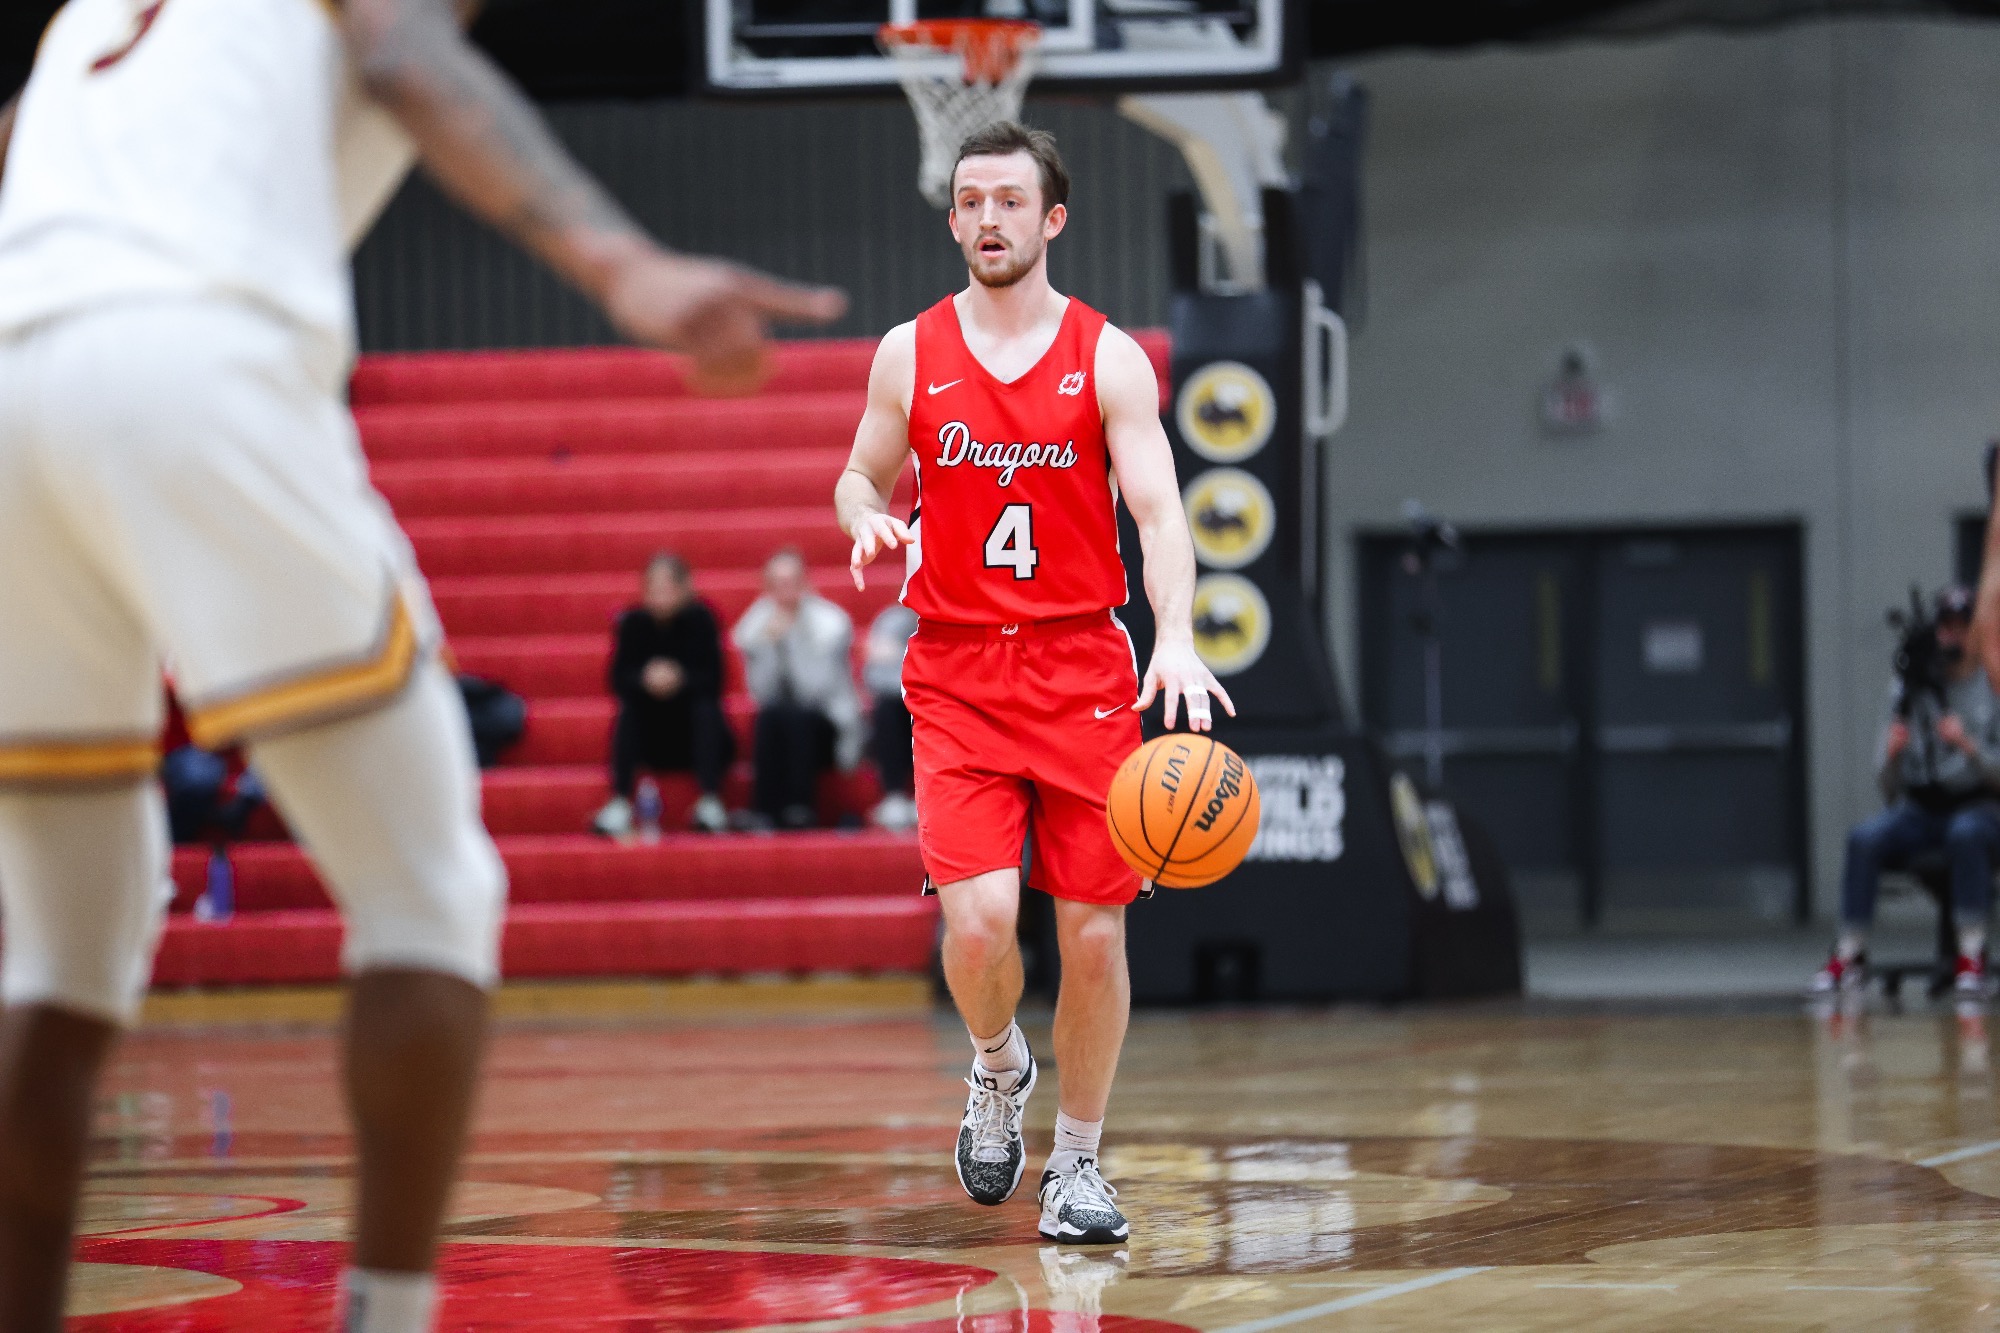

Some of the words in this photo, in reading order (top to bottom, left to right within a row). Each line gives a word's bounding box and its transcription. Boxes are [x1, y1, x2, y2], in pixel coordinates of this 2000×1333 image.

[936, 420, 1078, 487] Dragons
[983, 502, 1039, 580] 4
[1194, 751, 1244, 832] Wilson
